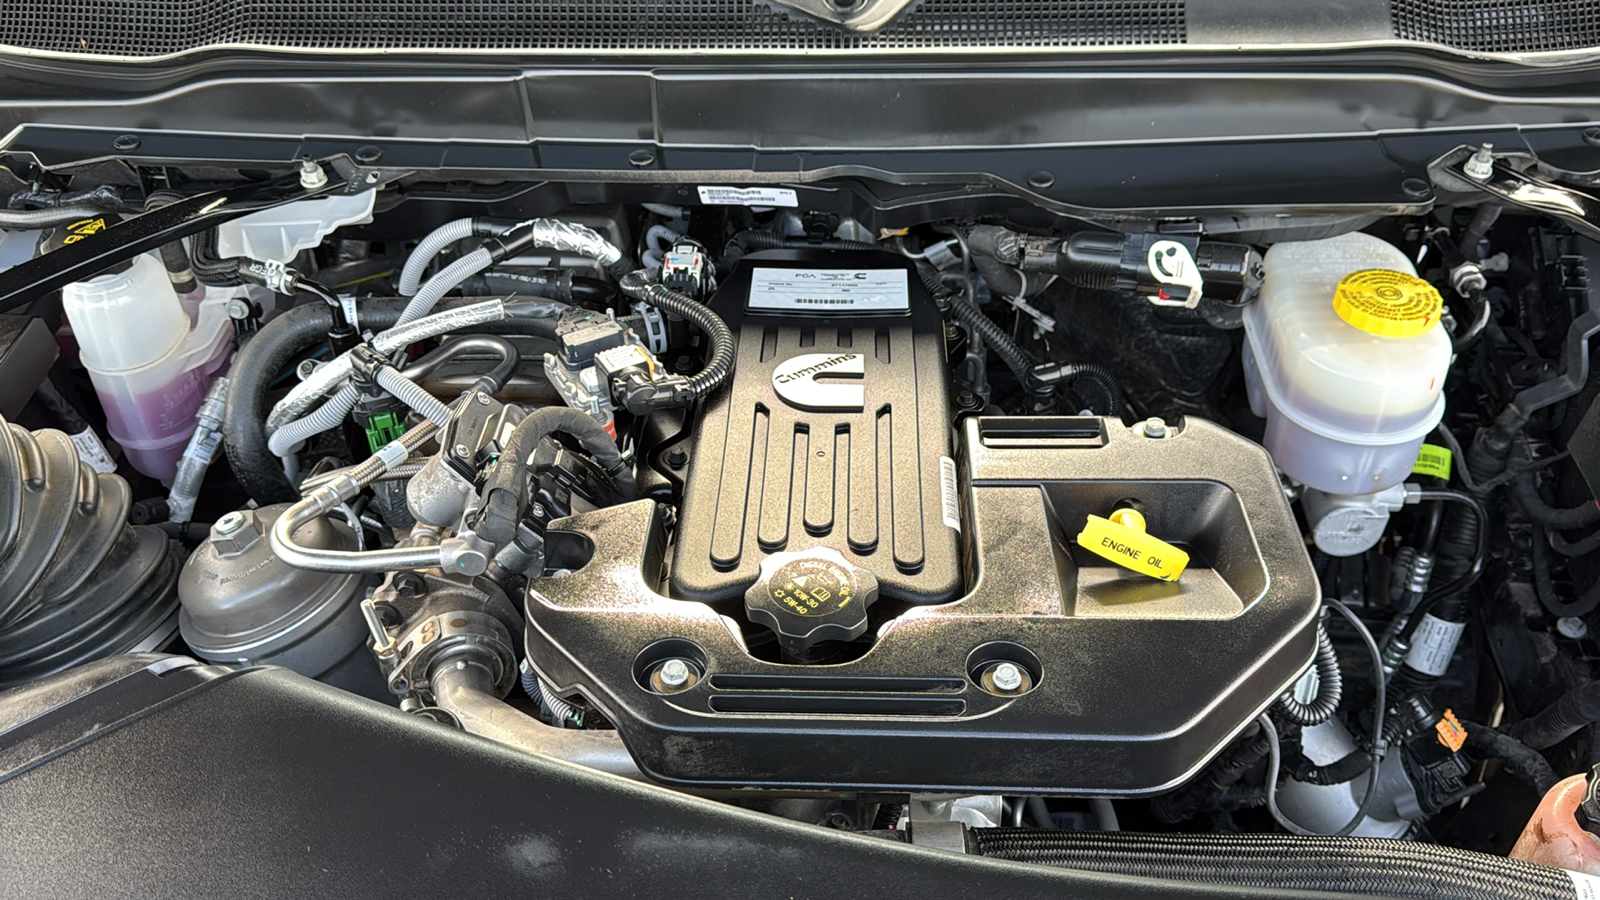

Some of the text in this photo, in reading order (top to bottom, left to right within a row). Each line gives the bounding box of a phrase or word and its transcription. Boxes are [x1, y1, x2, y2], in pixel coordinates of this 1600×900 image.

[775, 353, 857, 384] Cummins
[1101, 536, 1163, 570] ENGINE OIL
[799, 560, 828, 571] DIESEL
[783, 596, 808, 615] 5W-40
[793, 588, 819, 609] 10W-30
